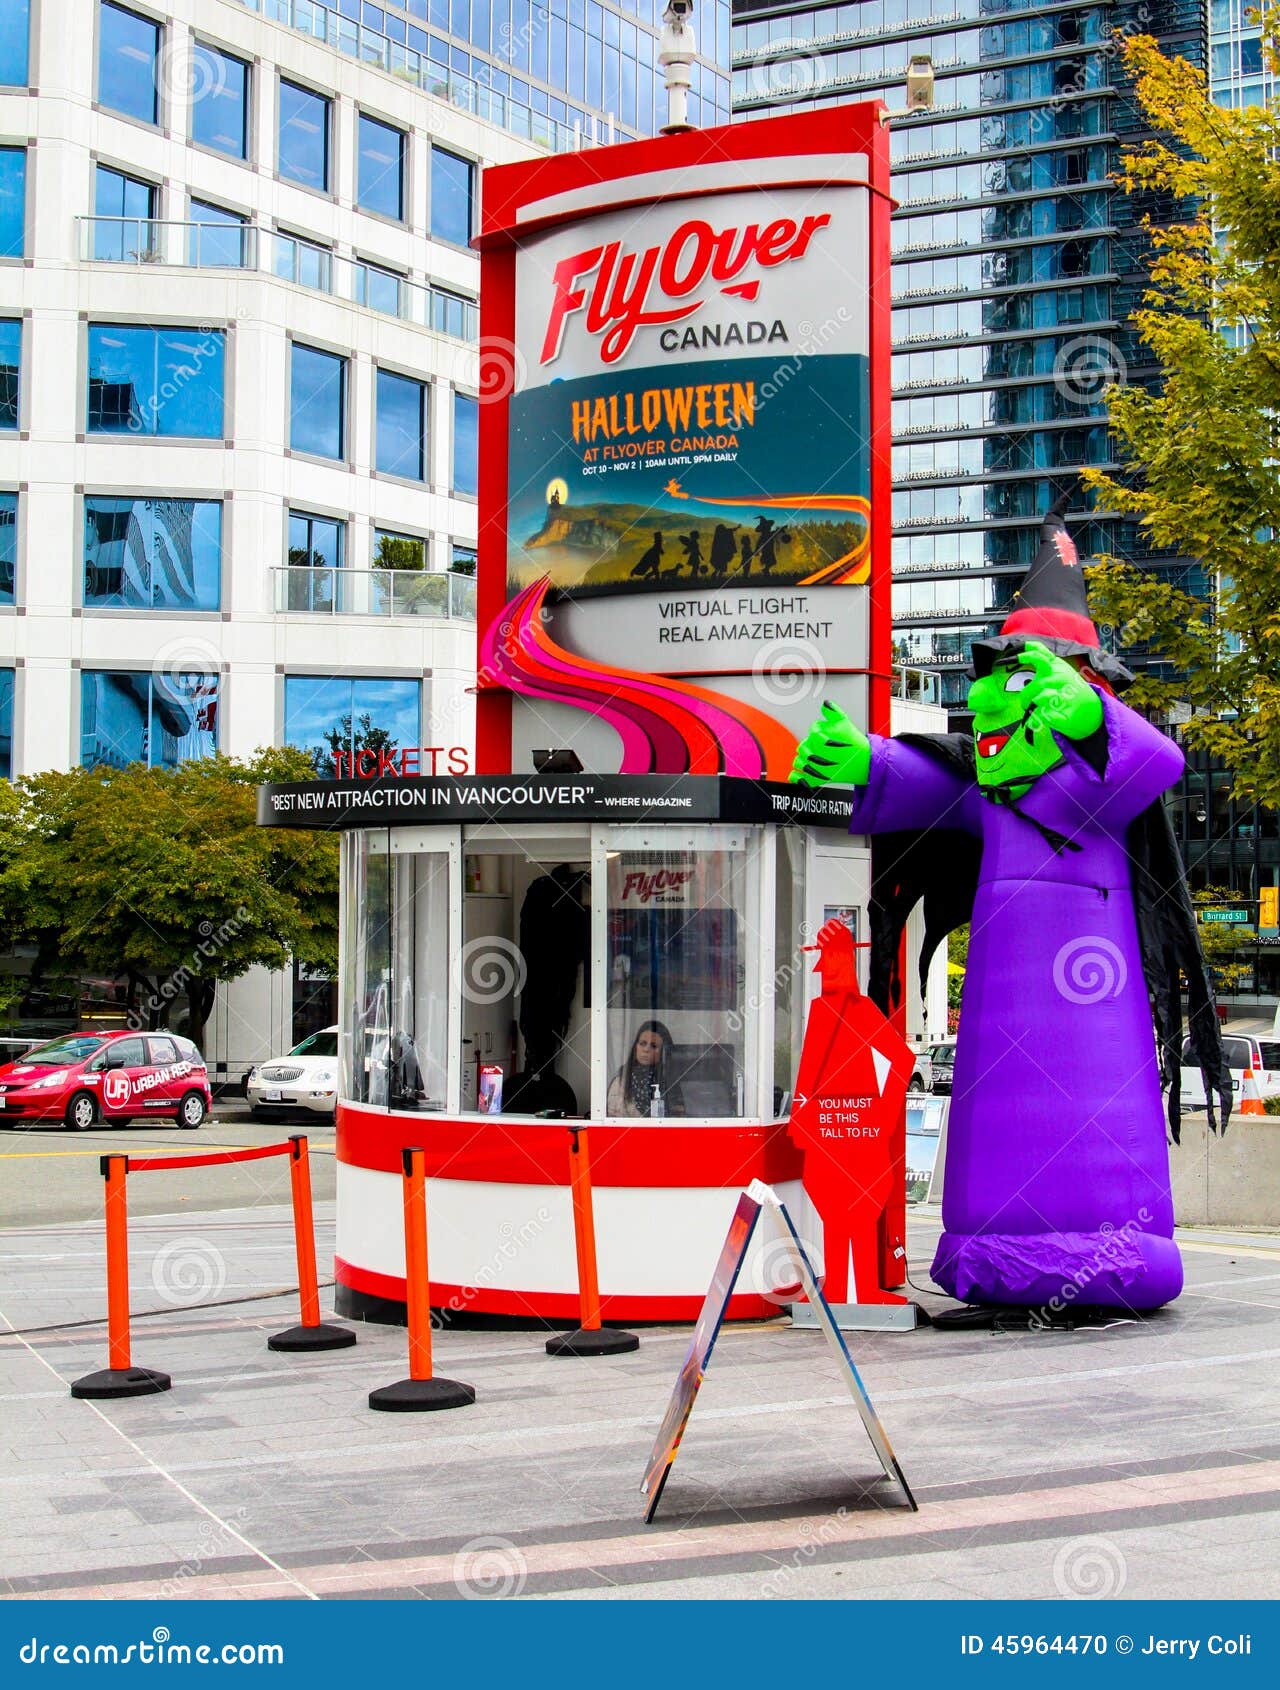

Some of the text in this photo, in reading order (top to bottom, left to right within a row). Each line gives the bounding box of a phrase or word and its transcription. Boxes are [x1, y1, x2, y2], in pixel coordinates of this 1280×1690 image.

[538, 213, 832, 365] FlyOver
[659, 319, 789, 351] CANADA
[571, 381, 755, 445] HALLOWEEN
[583, 434, 739, 462] AT FLYOVER CANADA
[582, 465, 597, 476] OCT
[598, 465, 607, 474] 10
[613, 462, 631, 472] NOV
[631, 461, 636, 470] 2
[645, 458, 667, 468] 10AM
[667, 456, 692, 466] UNTIL
[693, 455, 712, 464] 9PM
[714, 452, 738, 463] DAILY
[658, 597, 809, 618] VIRTUAL FLIGHT.
[658, 622, 833, 643] REAL AMAZEMENT
[330, 746, 470, 779] TICKETS
[297, 791, 325, 810] NEW
[326, 788, 427, 808] ATTRACTION
[431, 788, 451, 805] IN
[642, 797, 693, 807] MAGAZINE
[771, 795, 854, 816] TRIP ADVISOR RATIN
[622, 869, 696, 903] FlyOver
[1206, 912, 1242, 920] Burrard St
[106, 1079, 129, 1100] UR
[131, 1068, 170, 1094] URBAN
[818, 1097, 873, 1109] YOU MUST
[819, 1112, 859, 1124] BE THIS
[819, 1127, 881, 1138] TALL TO FLY
